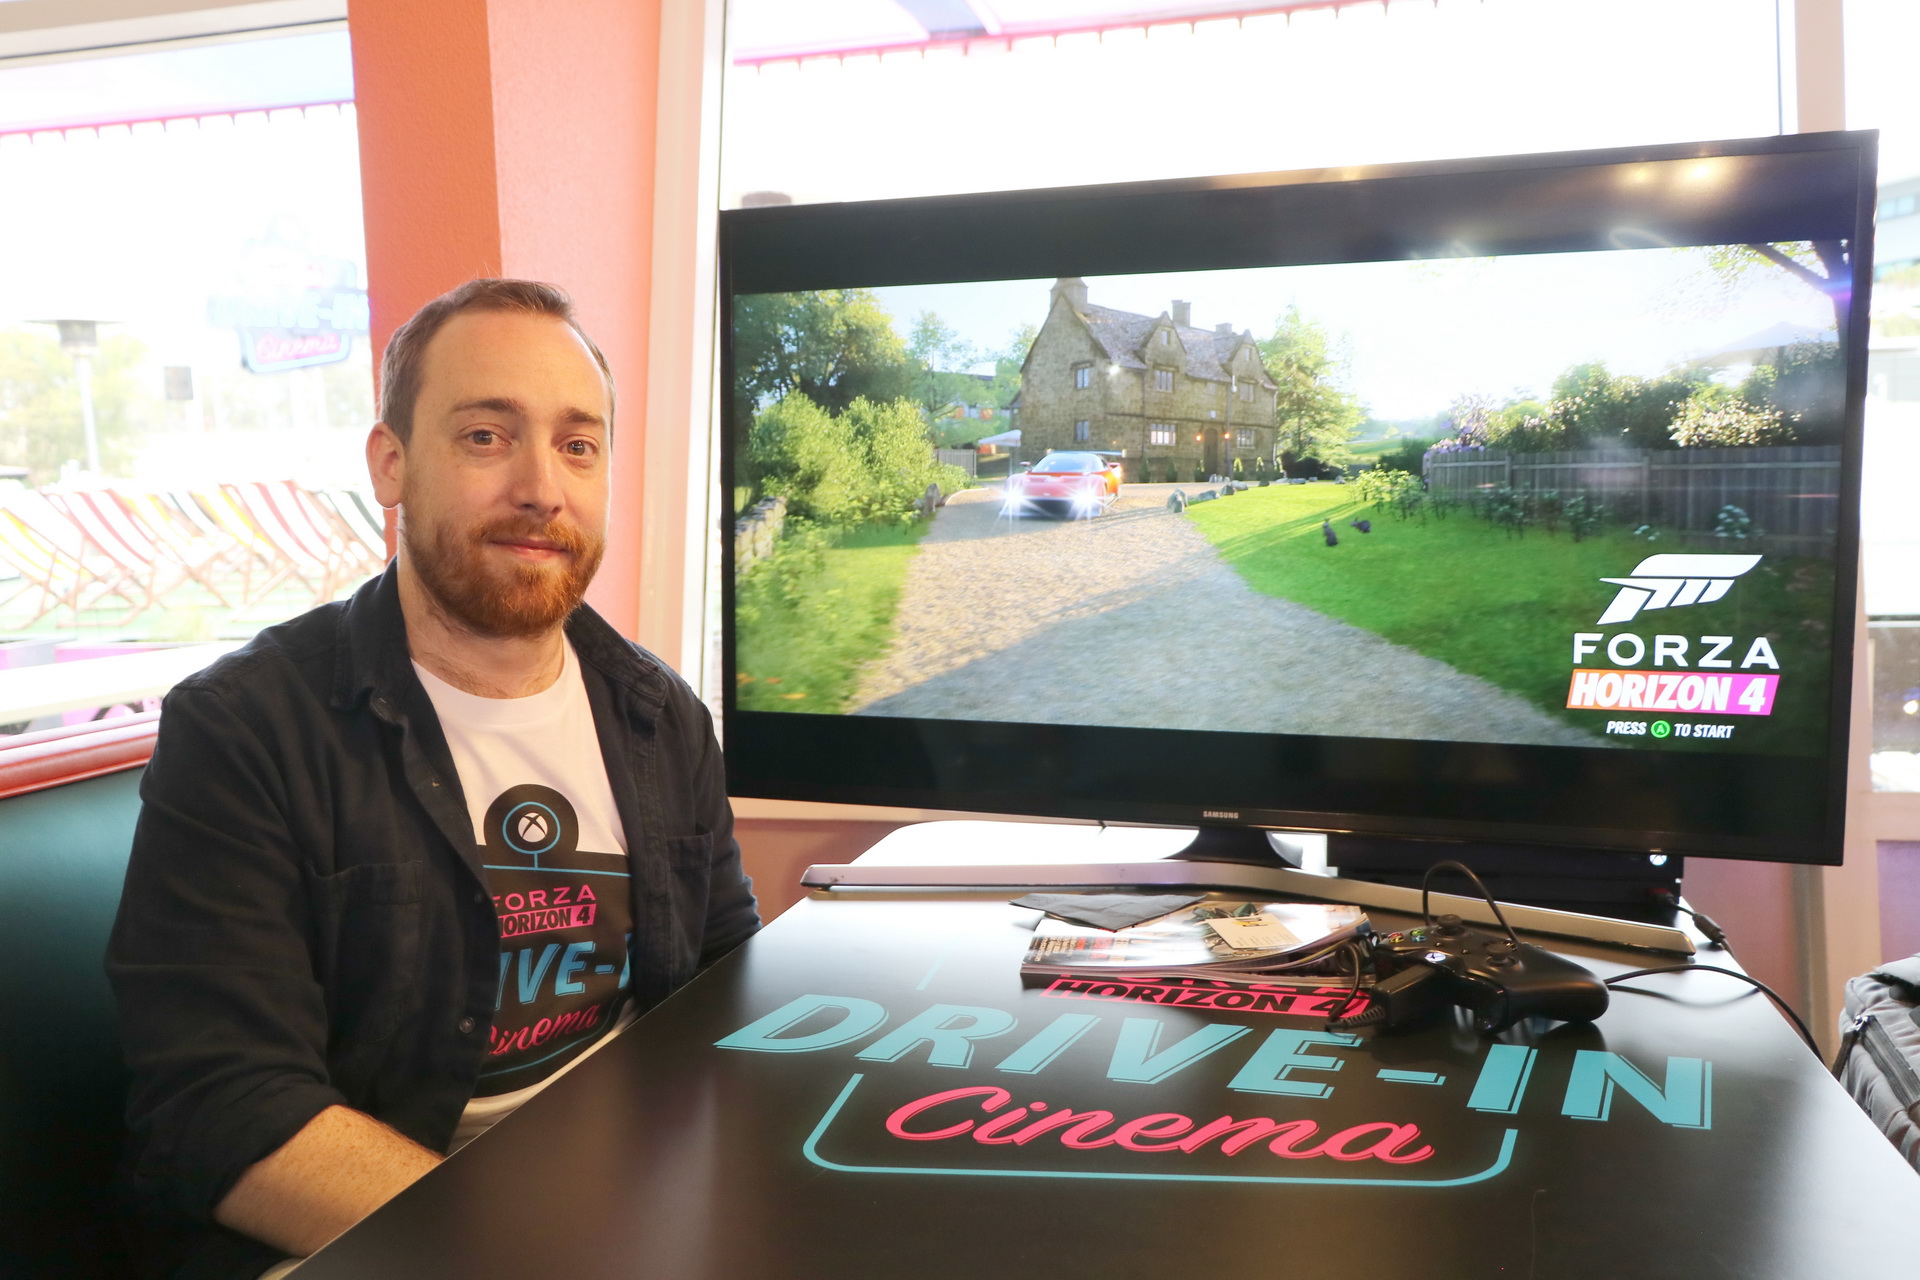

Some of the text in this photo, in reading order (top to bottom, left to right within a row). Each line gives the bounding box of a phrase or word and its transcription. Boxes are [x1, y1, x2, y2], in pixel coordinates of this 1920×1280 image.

[255, 332, 341, 363] Cinema
[1572, 632, 1780, 669] FORZA
[1570, 672, 1767, 712] HORIZON 4
[1605, 720, 1648, 735] PRESS
[1673, 723, 1692, 737] TO
[1692, 724, 1735, 739] START
[1202, 810, 1239, 819] SAMSUNG
[576, 906, 591, 925] 4
[1046, 980, 1297, 1012] HORIZON
[1309, 998, 1349, 1018] 4
[712, 994, 1712, 1130] DRIVE-IN
[885, 1086, 1435, 1165] Cinema
